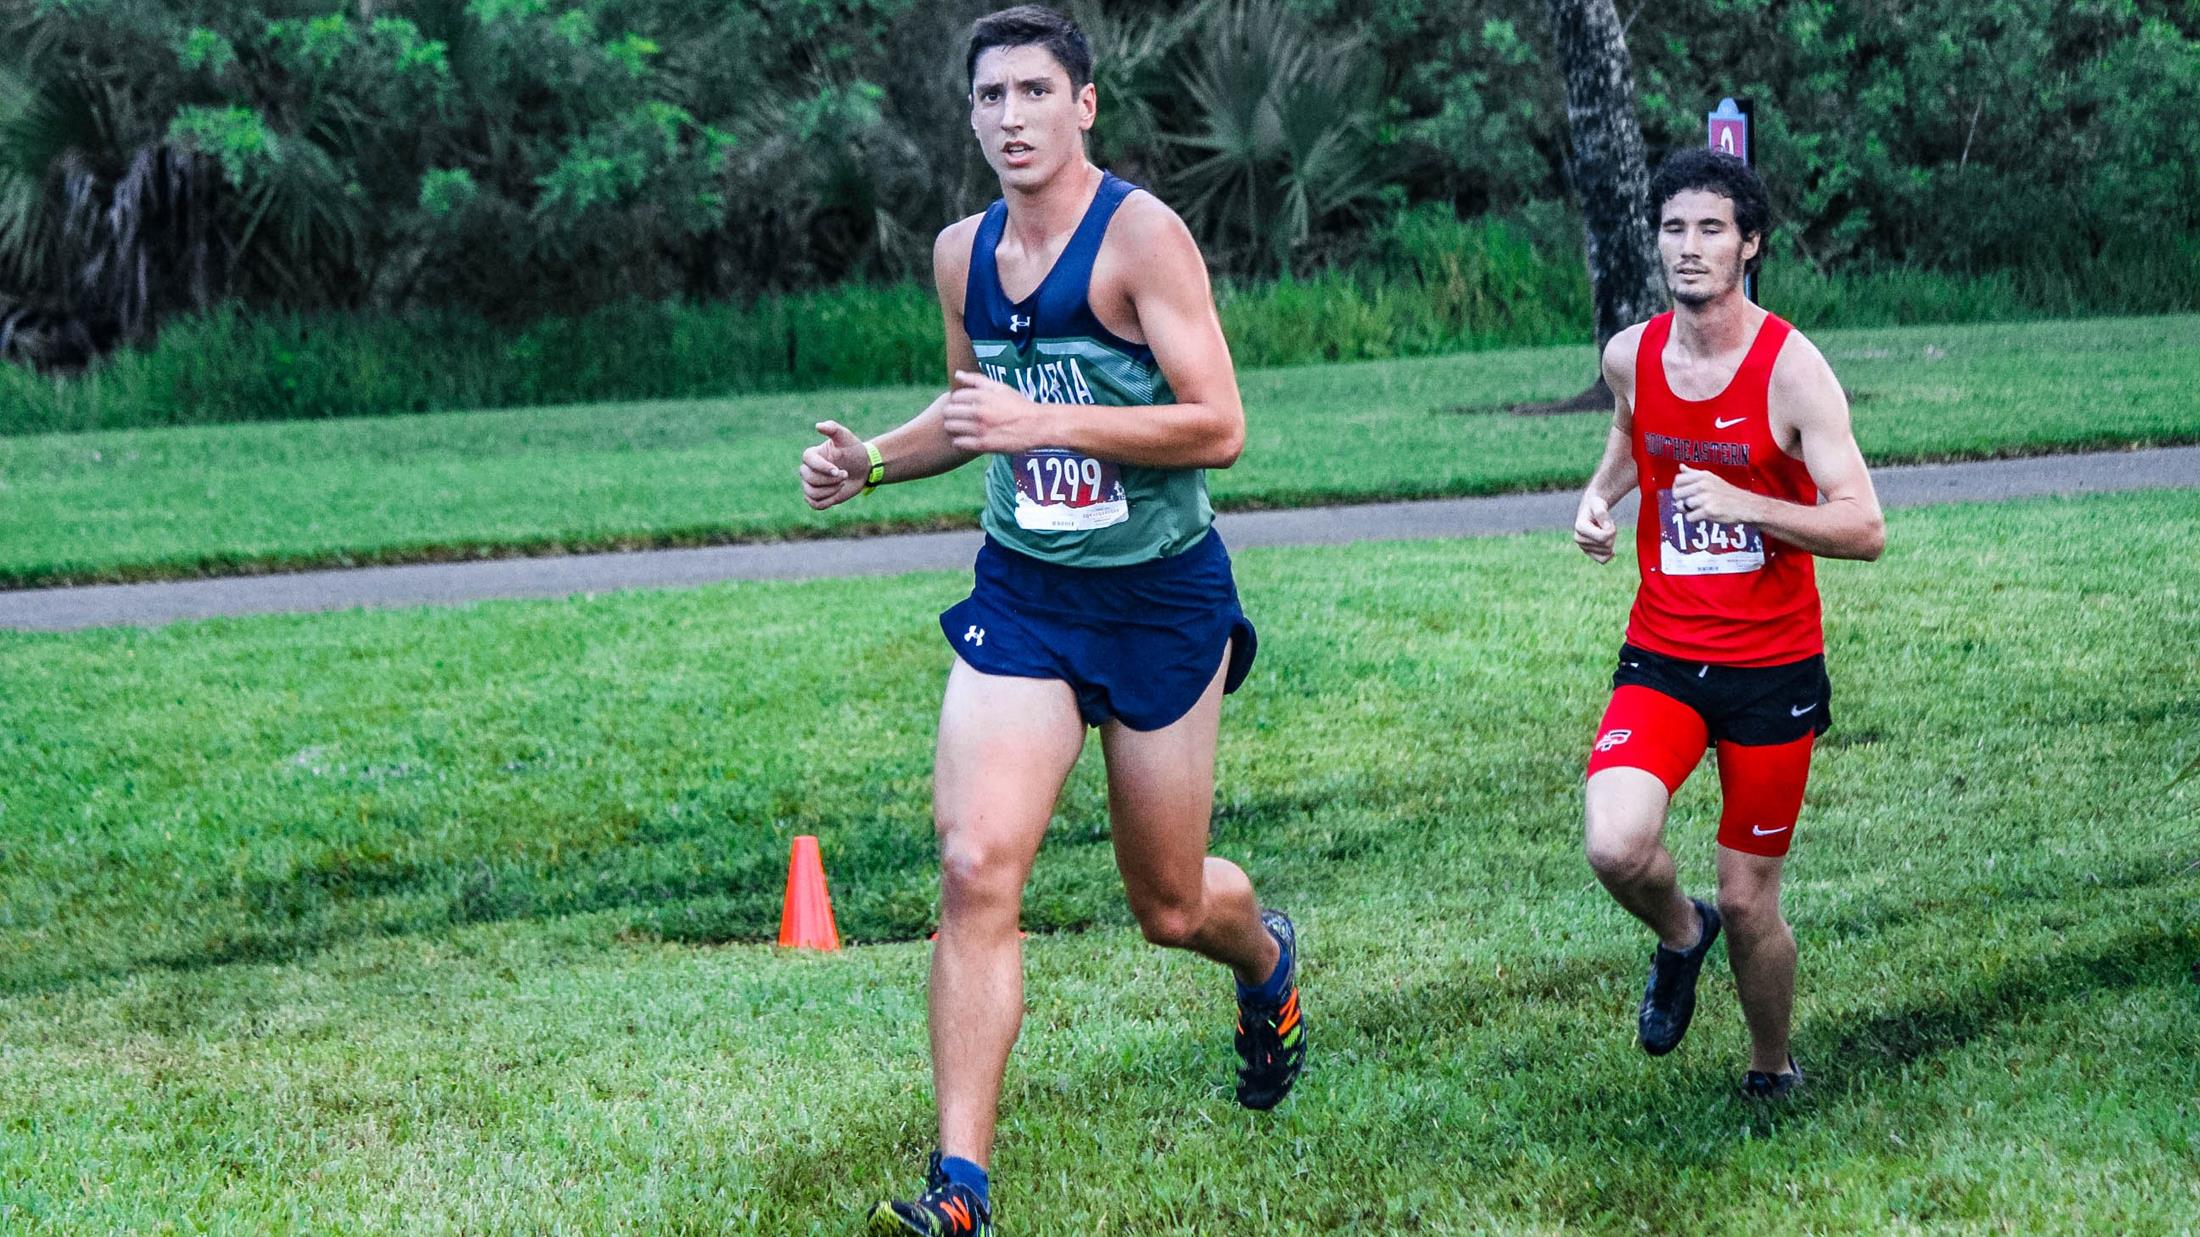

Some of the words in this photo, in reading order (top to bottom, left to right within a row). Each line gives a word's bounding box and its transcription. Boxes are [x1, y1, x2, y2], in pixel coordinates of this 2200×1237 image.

[1015, 357, 1095, 405] MARIA
[1026, 457, 1102, 502] 1299
[1672, 512, 1747, 550] 1343
